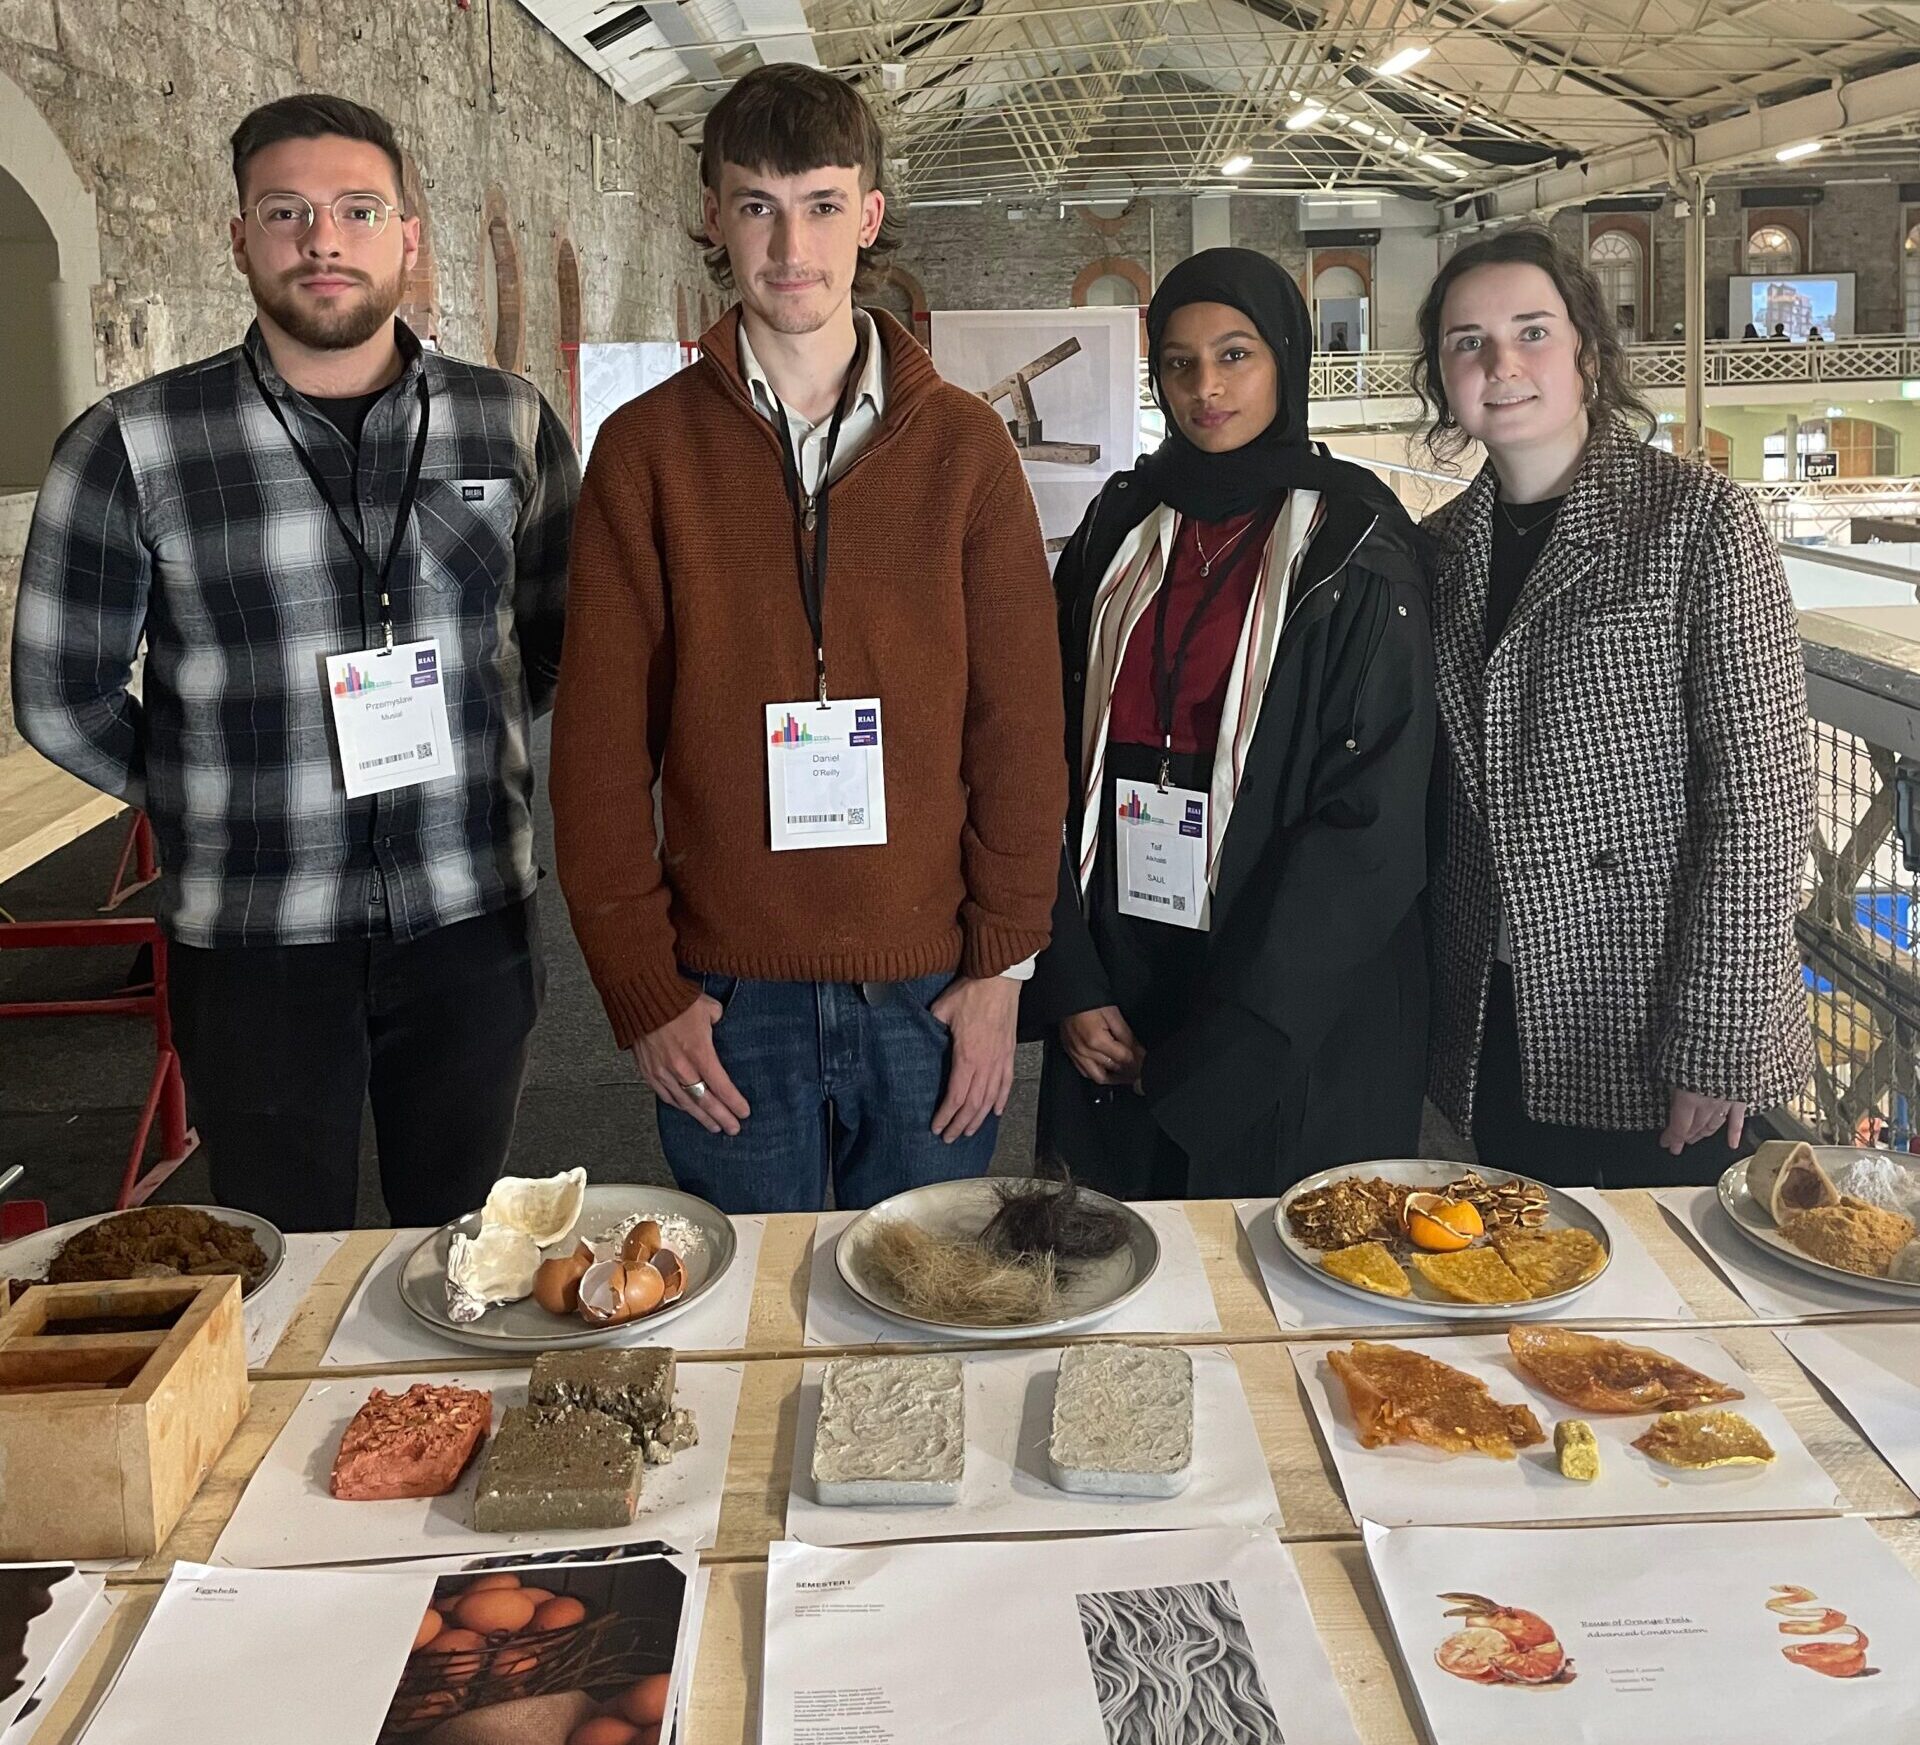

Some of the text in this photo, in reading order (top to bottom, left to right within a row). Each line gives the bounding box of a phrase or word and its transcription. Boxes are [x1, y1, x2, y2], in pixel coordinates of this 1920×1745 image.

[1807, 464, 1834, 476] EXIT
[857, 715, 875, 723] RIAI
[812, 754, 840, 763] Daniel
[812, 769, 840, 777] O'Reilly
[795, 1580, 845, 1588] SEMESTER
